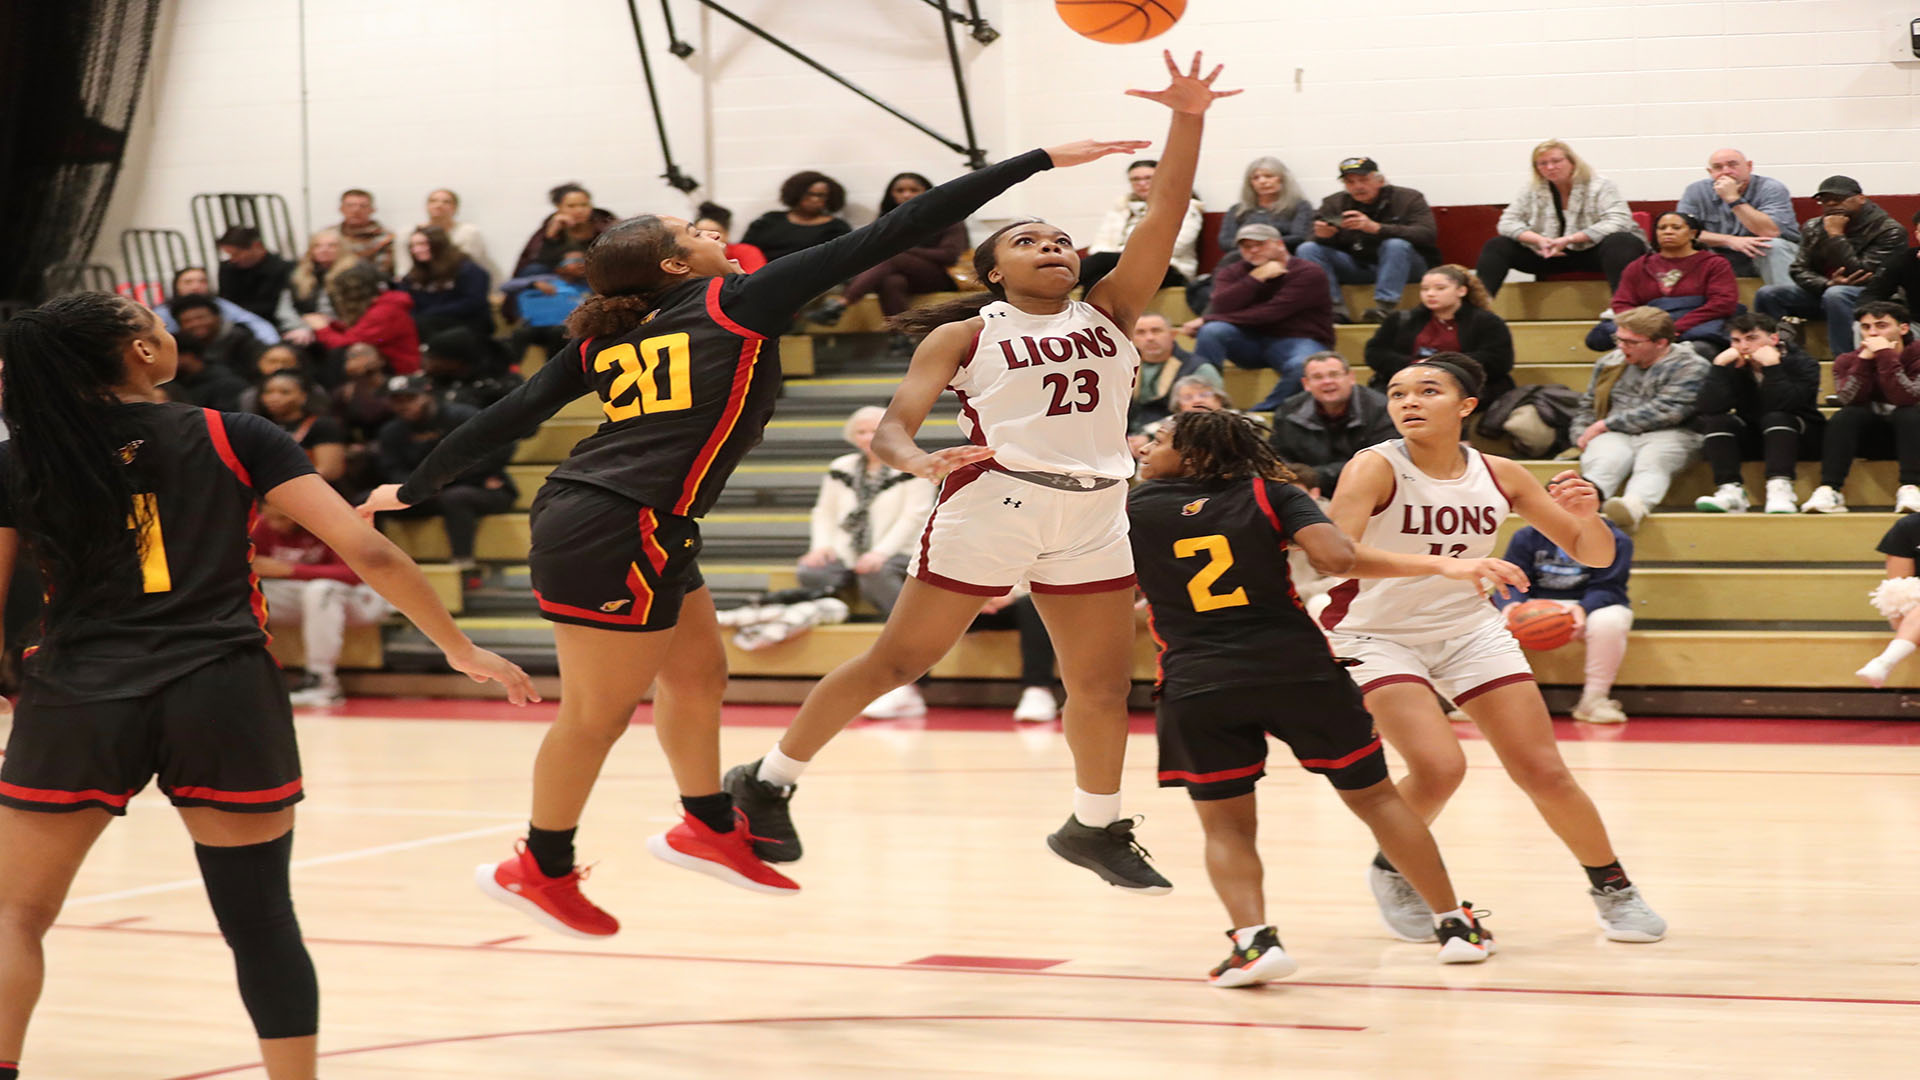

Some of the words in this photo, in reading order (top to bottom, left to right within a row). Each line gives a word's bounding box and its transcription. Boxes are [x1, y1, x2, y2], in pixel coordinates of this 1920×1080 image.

[999, 325, 1117, 370] LIONS
[594, 332, 692, 422] 20
[1042, 369, 1100, 416] 23
[1400, 504, 1497, 535] LIONS
[1173, 534, 1250, 613] 2
